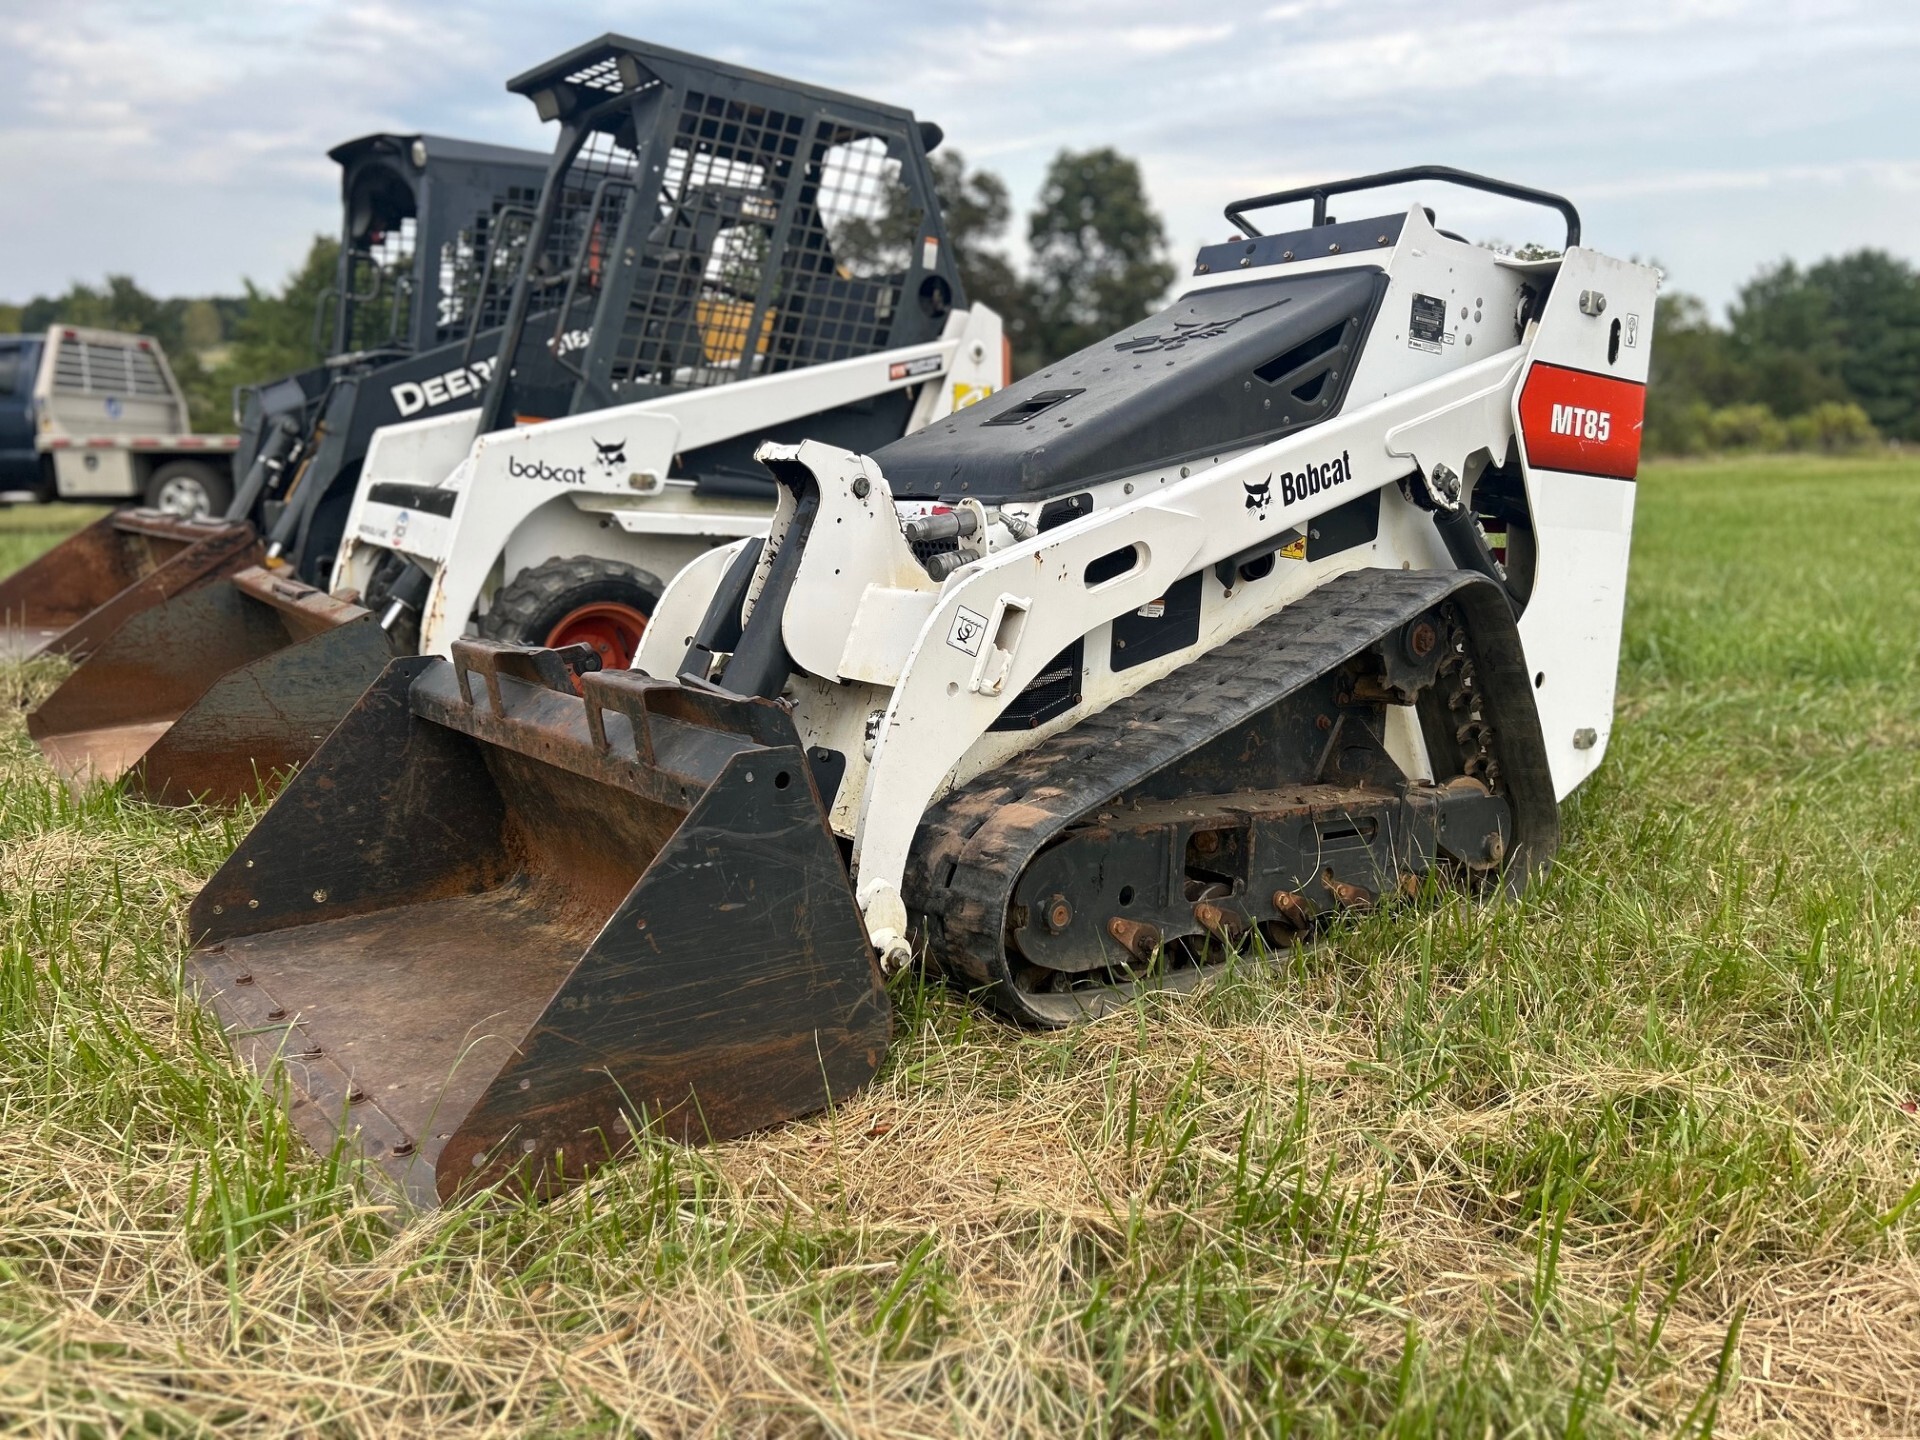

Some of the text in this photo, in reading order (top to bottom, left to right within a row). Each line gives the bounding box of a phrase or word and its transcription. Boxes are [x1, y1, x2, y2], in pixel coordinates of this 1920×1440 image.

[390, 355, 498, 417] DEER
[1550, 403, 1611, 442] MT85
[509, 455, 585, 484] bobcat
[1280, 449, 1352, 507] Bobcat
